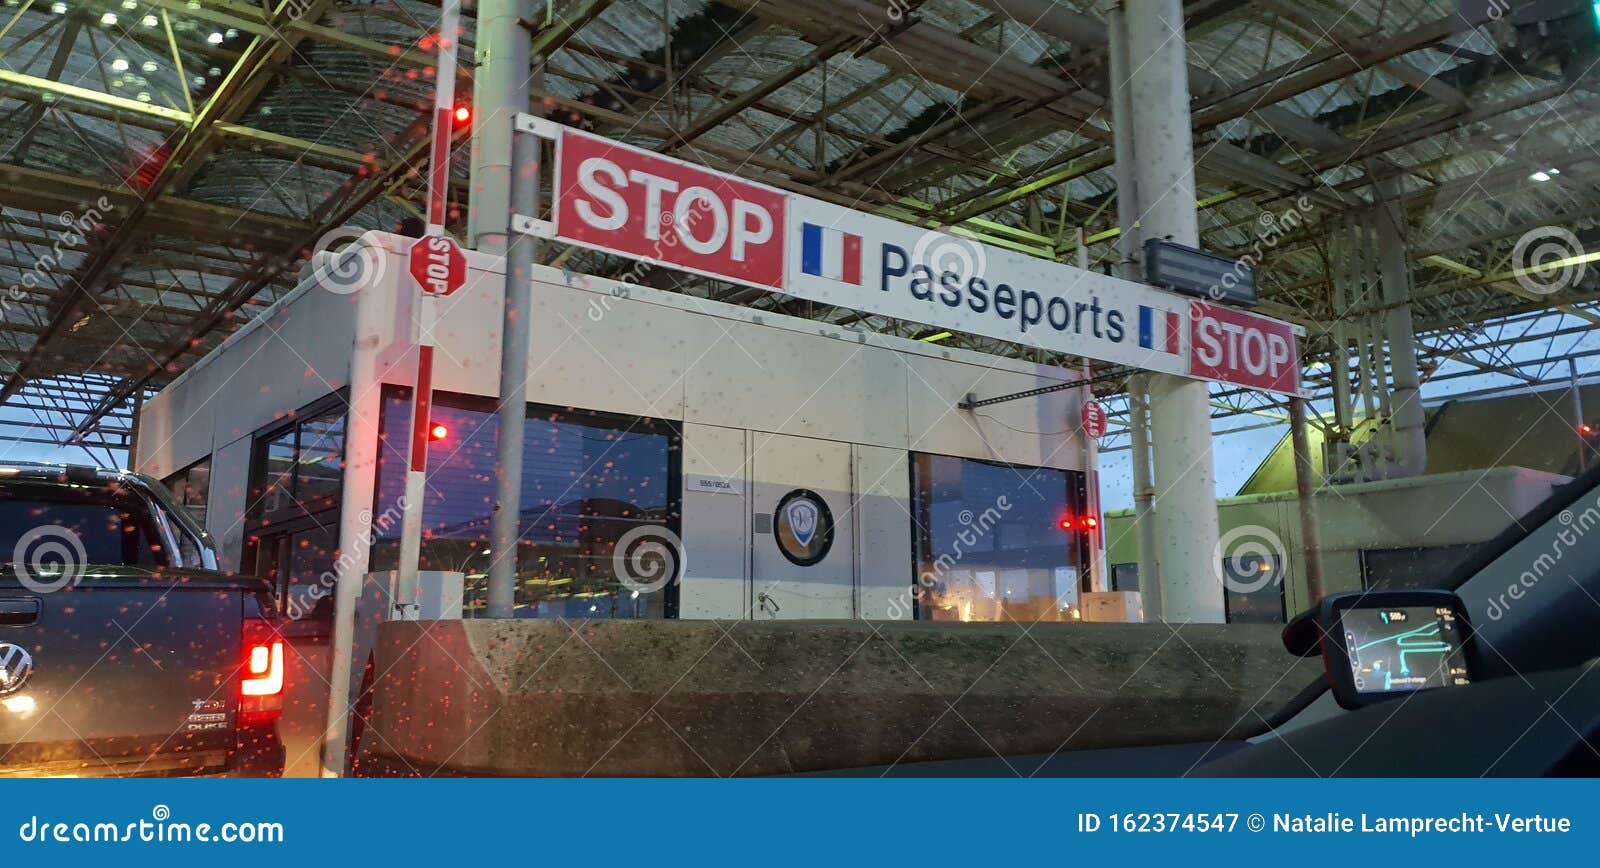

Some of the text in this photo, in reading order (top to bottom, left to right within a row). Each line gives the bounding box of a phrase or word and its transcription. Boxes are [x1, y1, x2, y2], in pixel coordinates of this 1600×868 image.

[574, 157, 774, 262] STOP
[427, 238, 451, 294] STOP
[881, 242, 1126, 344] Passeports
[1199, 316, 1291, 379] STOP
[1087, 402, 1099, 438] STOP
[188, 722, 228, 730] DUKE
